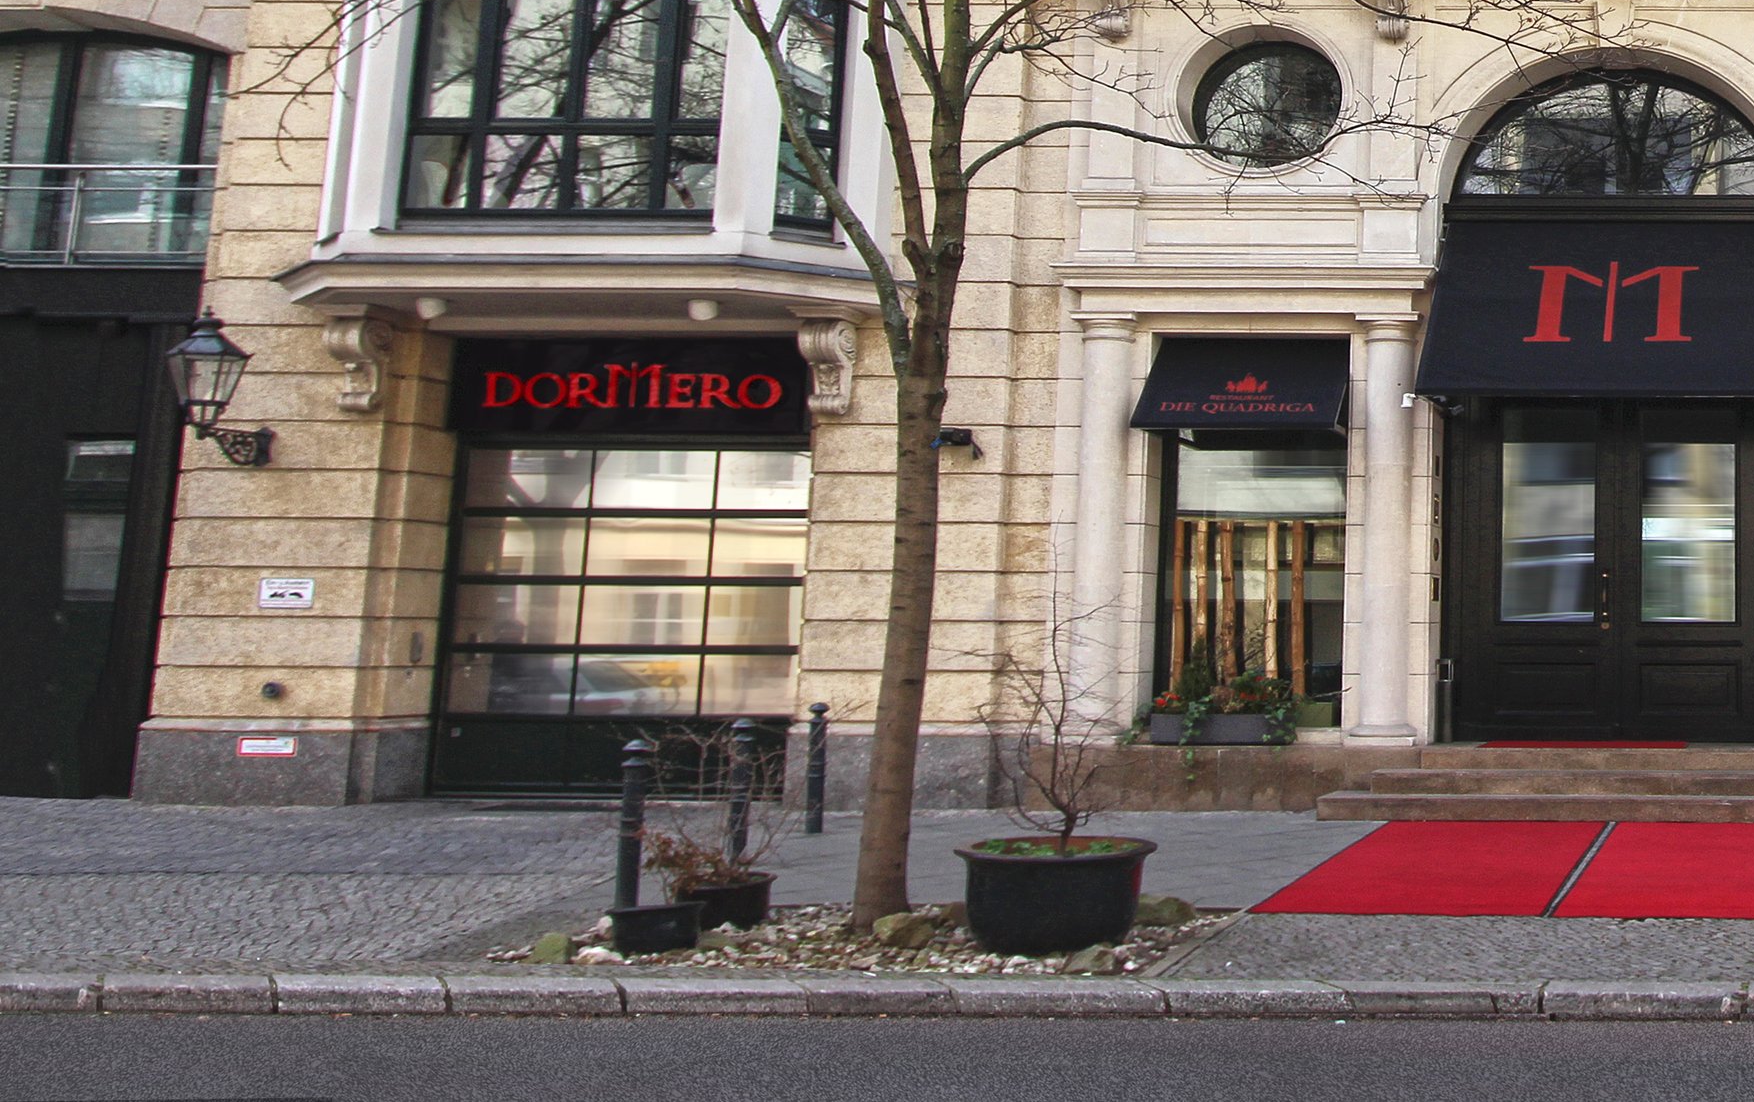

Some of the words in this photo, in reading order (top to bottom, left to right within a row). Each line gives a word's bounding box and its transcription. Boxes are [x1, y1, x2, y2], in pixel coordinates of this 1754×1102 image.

[481, 361, 783, 409] DORMERO
[1159, 401, 1196, 412] DIE
[1202, 402, 1315, 414] QUADRIGA
